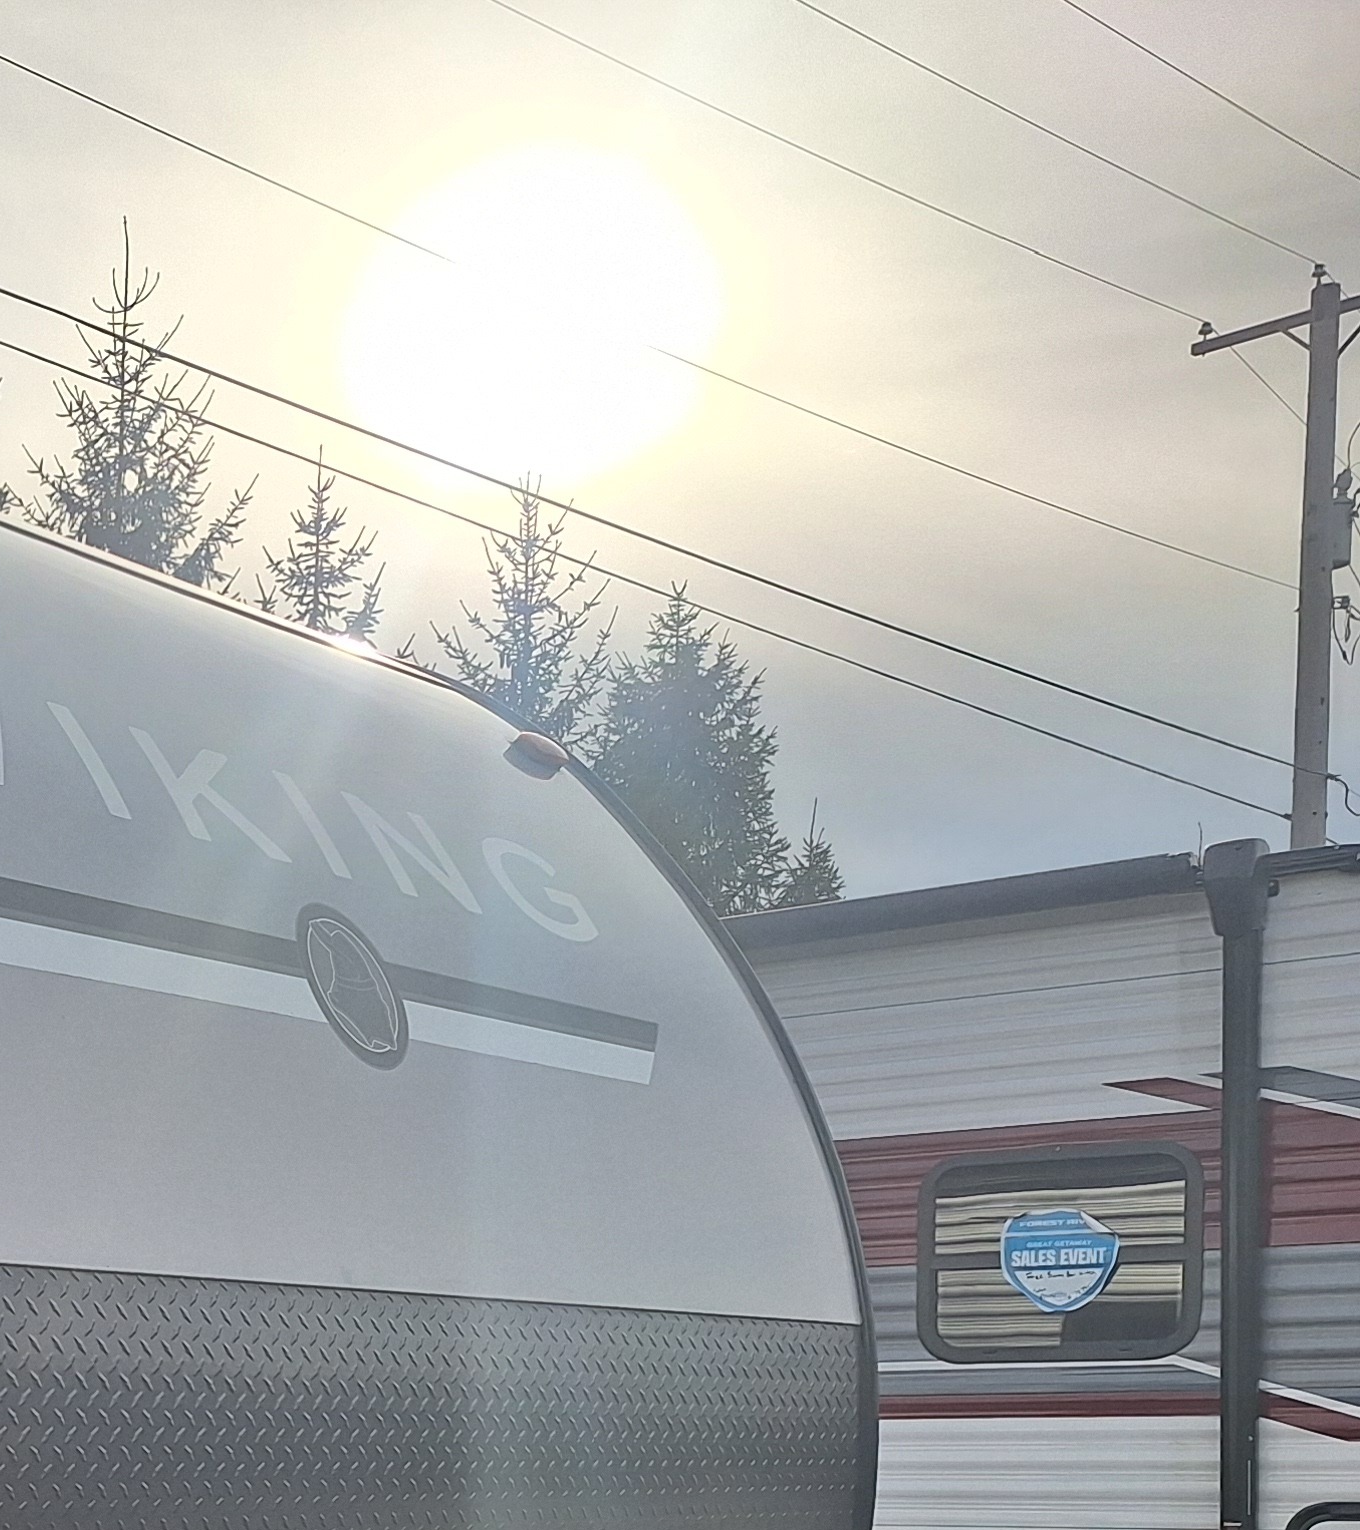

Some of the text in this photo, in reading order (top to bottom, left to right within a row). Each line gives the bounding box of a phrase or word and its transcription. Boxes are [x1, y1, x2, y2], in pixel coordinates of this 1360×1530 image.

[1019, 1219, 1065, 1227] FOREST
[1026, 1239, 1092, 1248] GREAT GETAWAY
[1011, 1246, 1108, 1267] SALES EVENT
